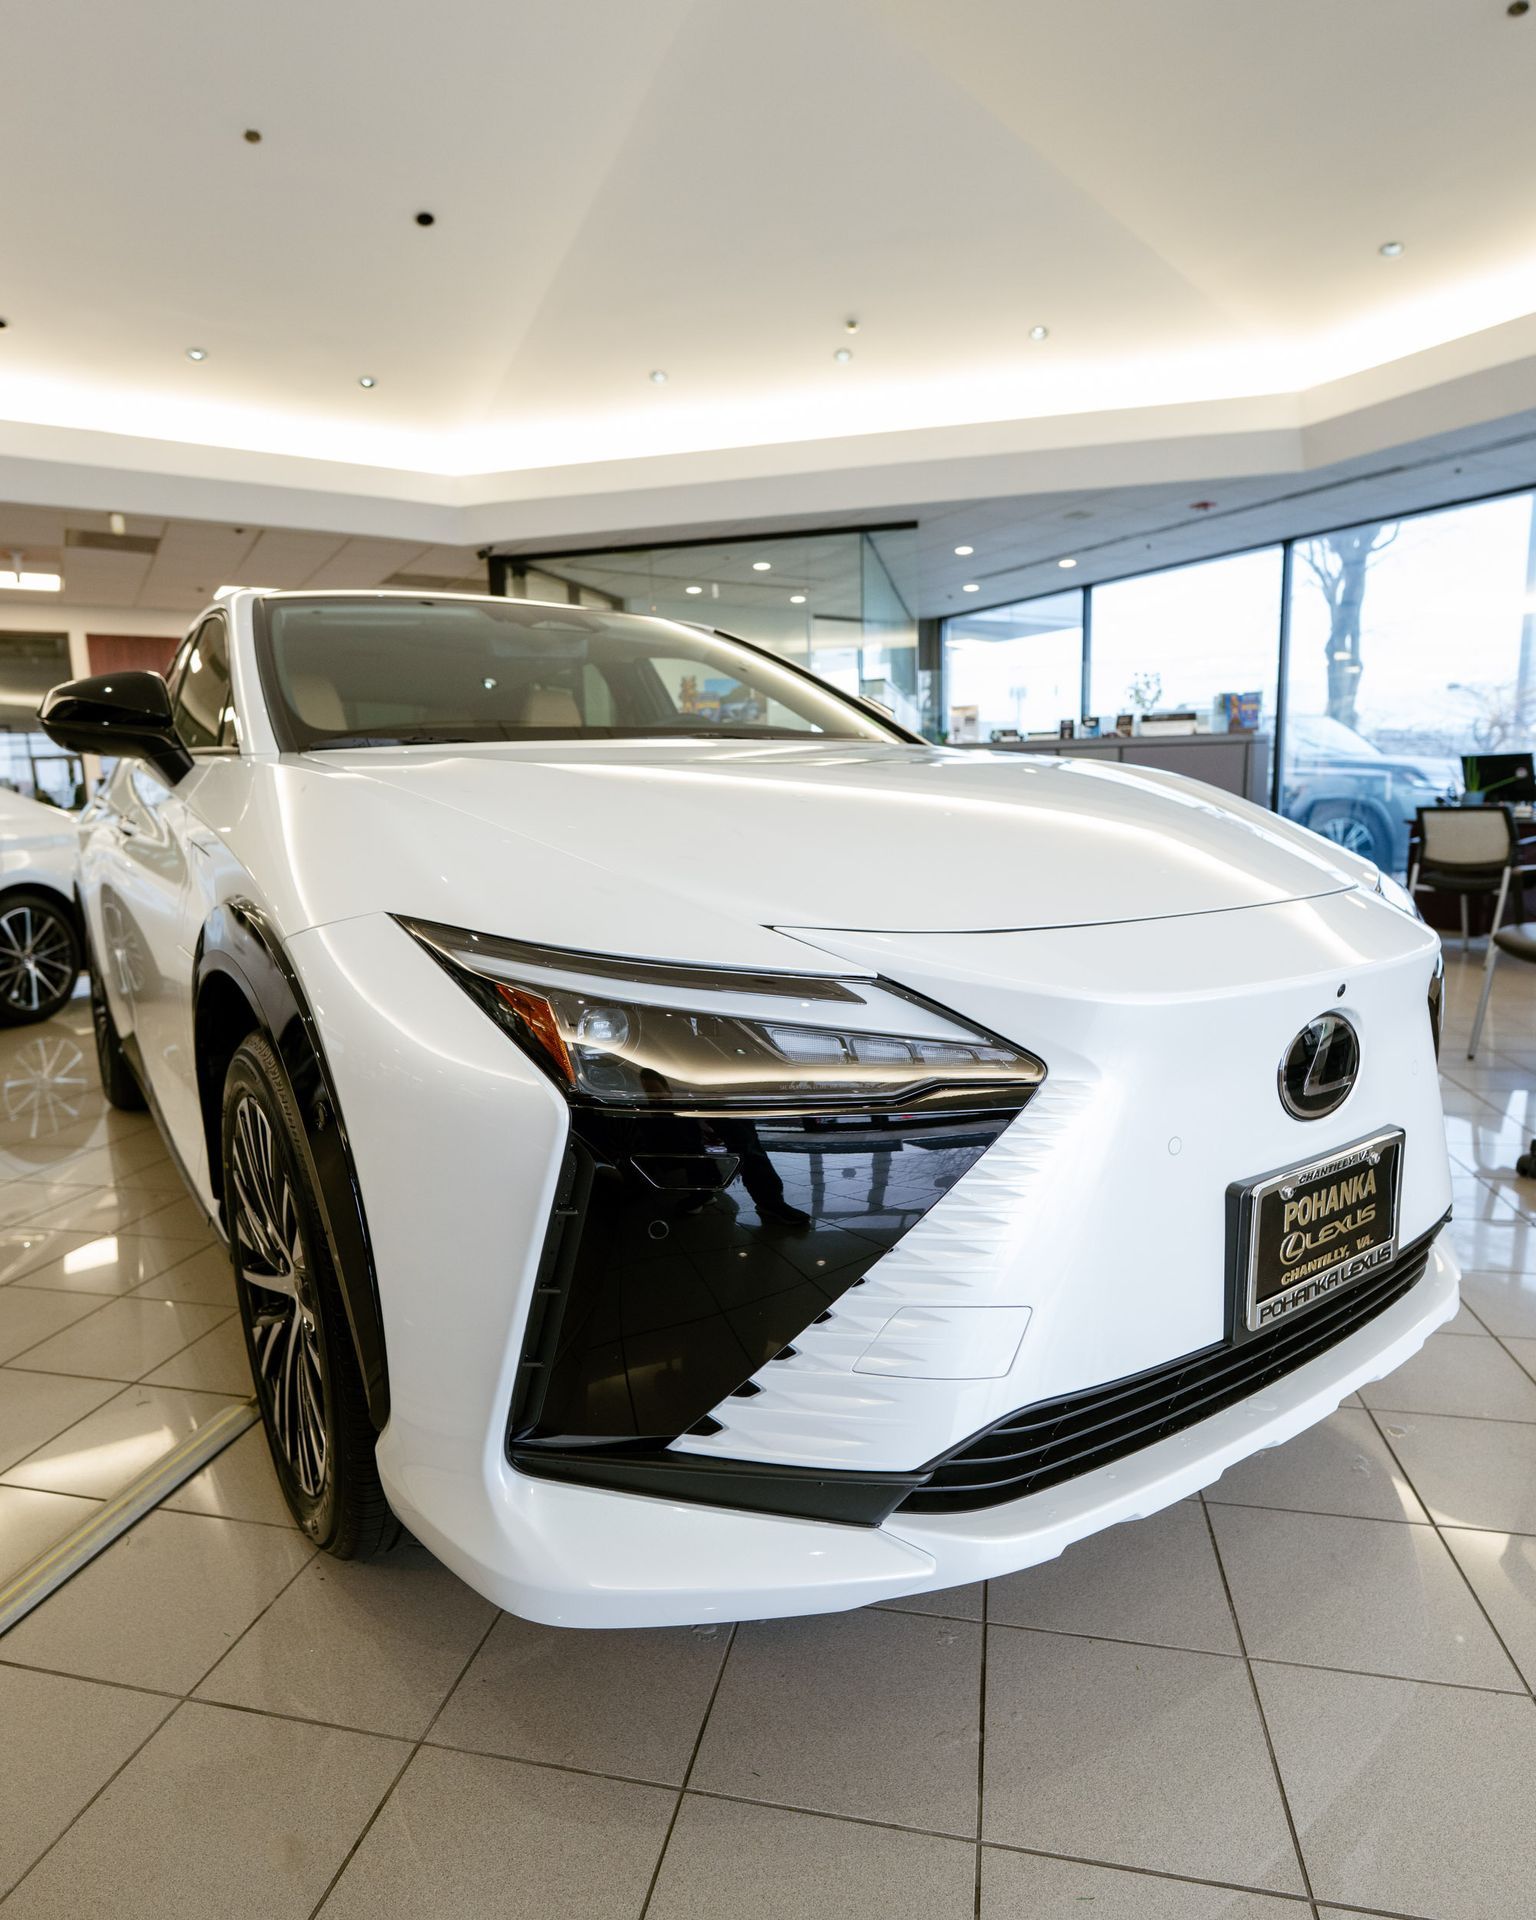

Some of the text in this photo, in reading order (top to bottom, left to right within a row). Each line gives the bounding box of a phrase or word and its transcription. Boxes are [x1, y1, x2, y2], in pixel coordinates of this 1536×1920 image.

[1283, 1168, 1377, 1233] POHANKA
[1305, 1203, 1376, 1249] LEXUS
[1260, 1247, 1392, 1324] POHANKA LEXUS
[1281, 1233, 1374, 1286] CHANTILLY, VA.
